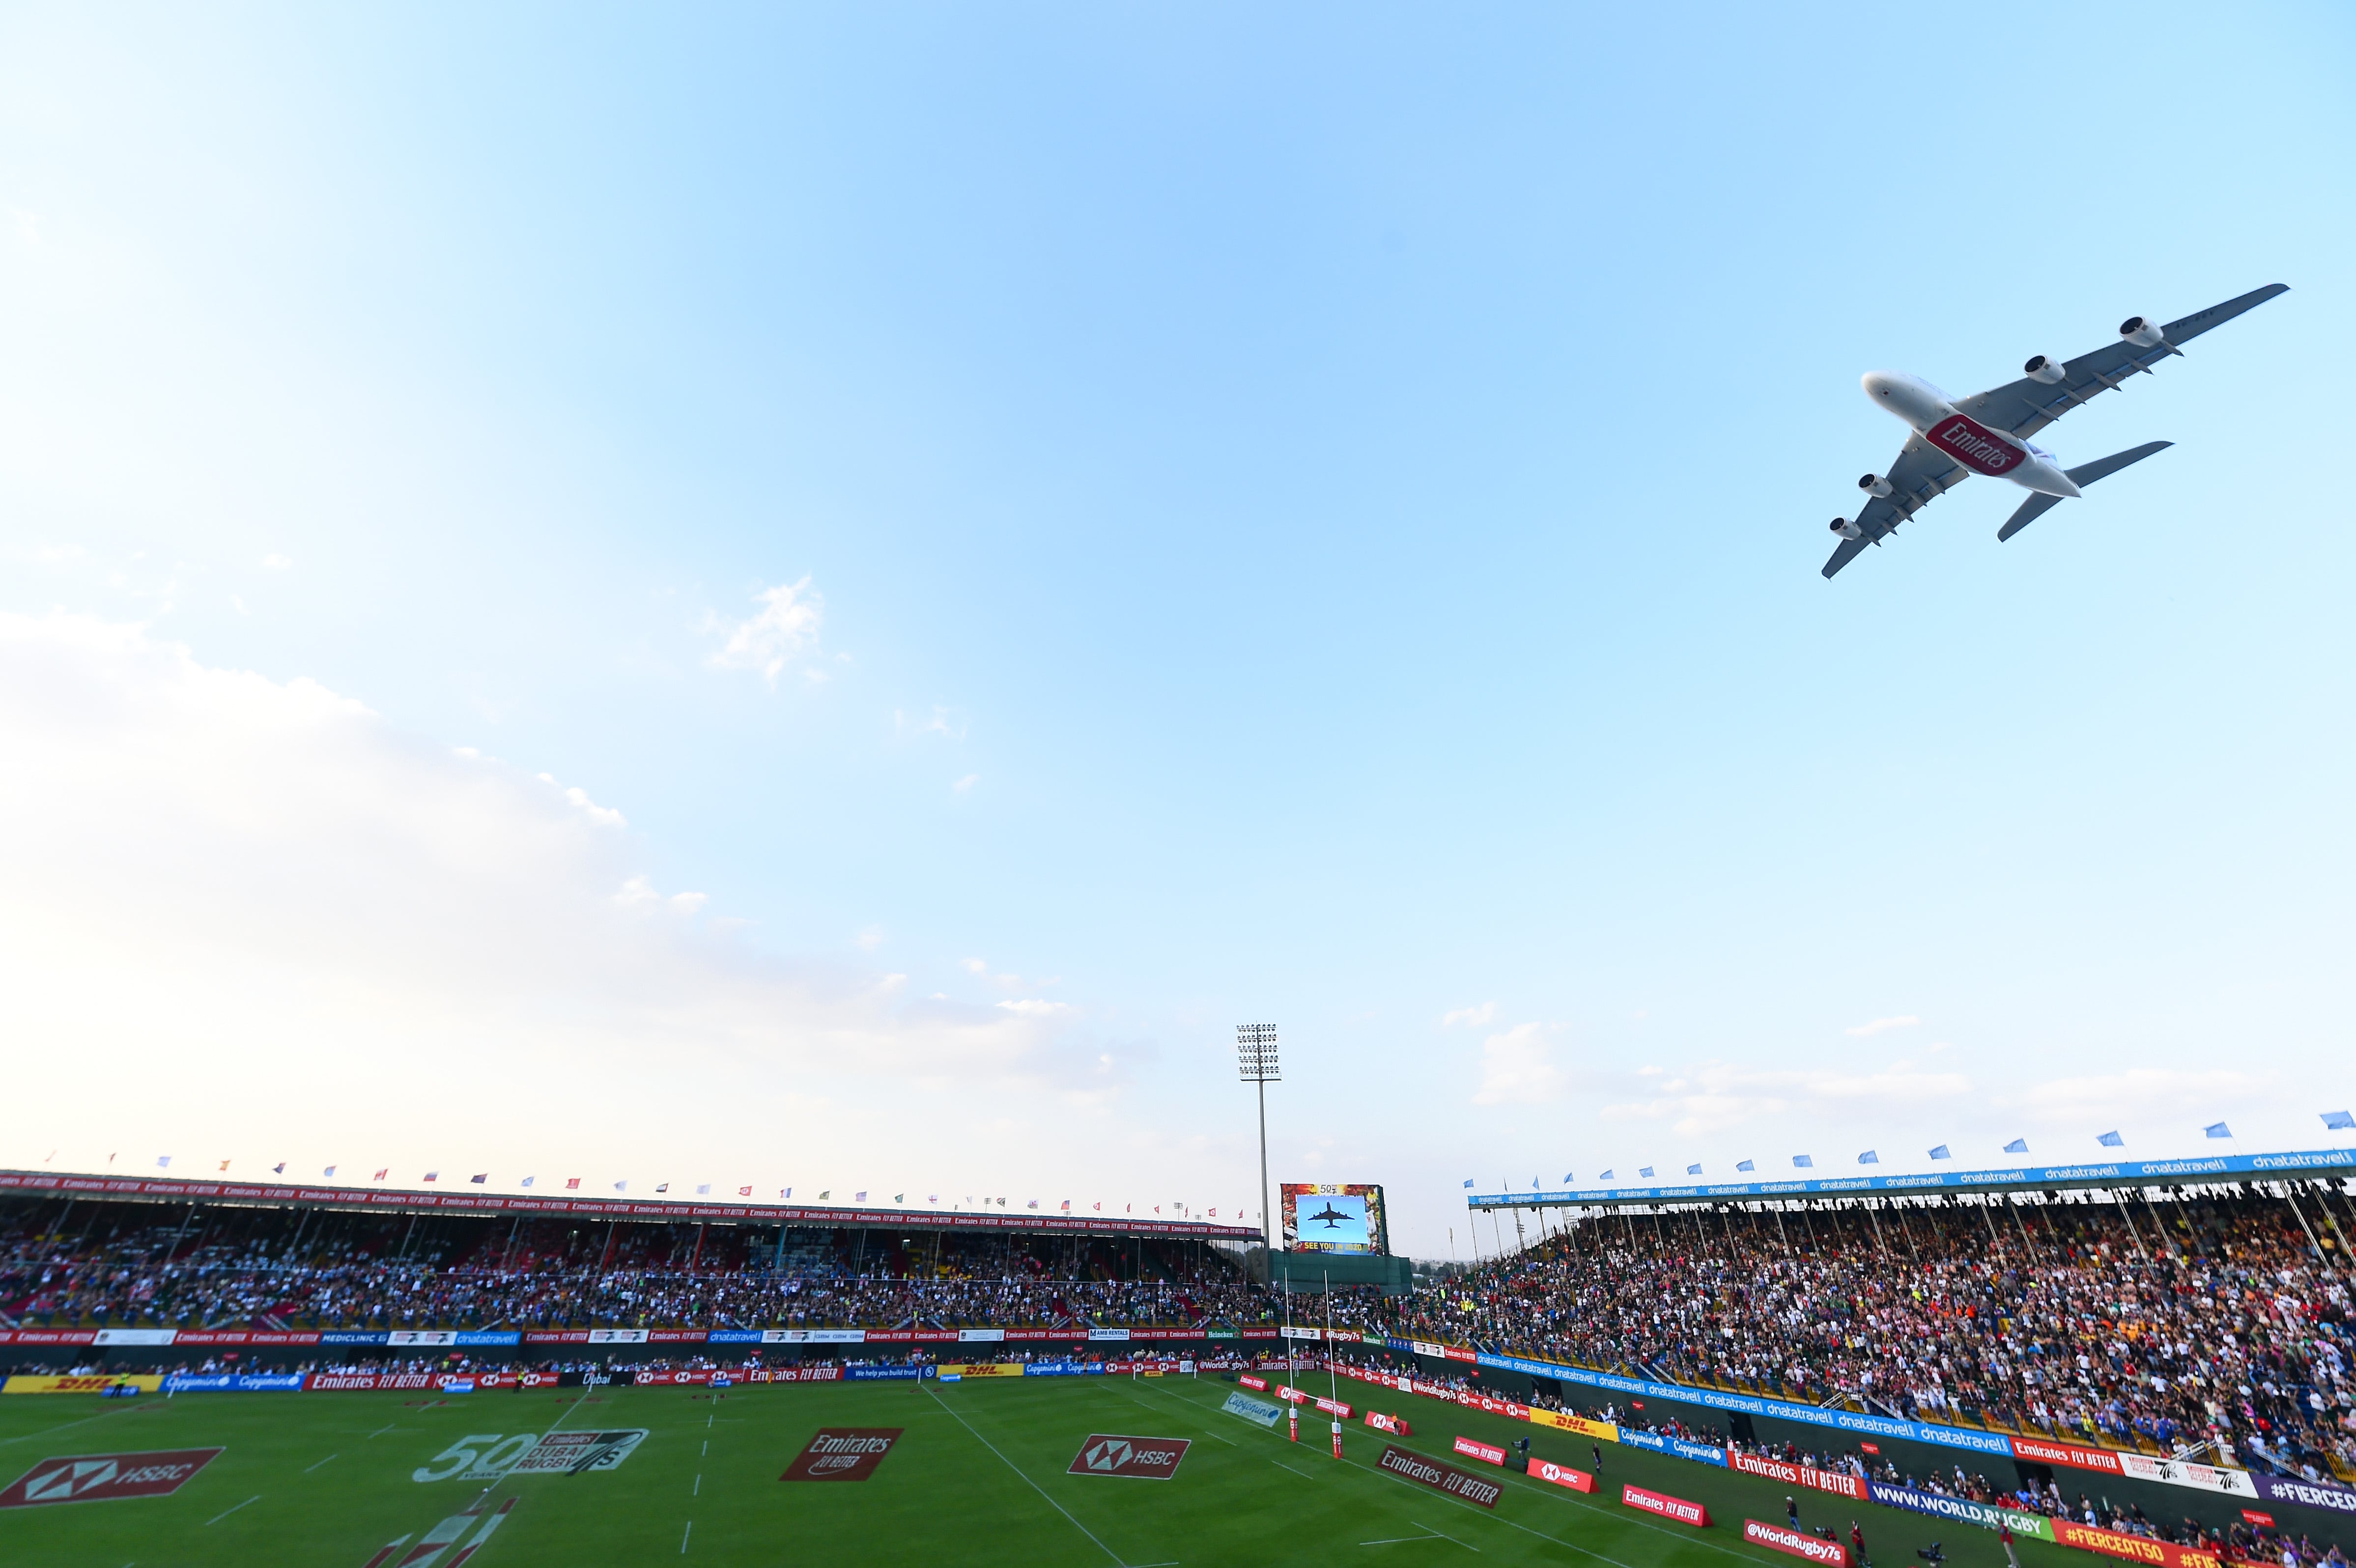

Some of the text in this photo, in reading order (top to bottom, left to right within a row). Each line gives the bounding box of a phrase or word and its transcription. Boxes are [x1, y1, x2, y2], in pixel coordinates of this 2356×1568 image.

[1941, 422, 2011, 468] Emirates
[1320, 1185, 1332, 1194] 50
[1326, 1330, 1360, 1341] #Rugby7s
[1363, 1335, 1381, 1344] Heineken
[965, 1366, 997, 1375] DHL
[1026, 1363, 1056, 1374] Capgemini
[1068, 1363, 1096, 1373] Capgeini
[1199, 1361, 1249, 1371] @WorldRgby7s
[238, 1375, 290, 1389] Capgemini
[312, 1375, 375, 1389] Emirates
[377, 1375, 394, 1389] FLY
[394, 1374, 429, 1388] BETTER
[582, 1372, 612, 1385] Dubai
[750, 1368, 838, 1381] Emrates FLY BETTER
[865, 1370, 876, 1379] help
[55, 1378, 113, 1389] DHL
[1413, 1381, 1457, 1400] @WorldRugby7s
[1227, 1394, 1270, 1417] Capgemini
[1555, 1415, 1589, 1433] DHL
[545, 1434, 596, 1444] Emirates
[808, 1434, 891, 1453] Emirates
[1621, 1429, 1656, 1447] Capgemini
[527, 1446, 586, 1458] DUBAI
[1455, 1440, 1480, 1456] Emirates
[1486, 1449, 1503, 1465] BETTER
[1673, 1440, 1712, 1459] Capgemini
[2015, 1442, 2069, 1462] Emirates
[2071, 1450, 2086, 1464] FLY
[2086, 1453, 2118, 1470] BETTER
[412, 1433, 539, 1482] 50
[515, 1458, 575, 1469] RUGBY
[830, 1455, 861, 1468] BETTER
[1133, 1450, 1176, 1466] HSBC
[114, 1463, 195, 1484] HSBC
[1381, 1450, 1499, 1505] Emirates FLY BETTER
[1561, 1471, 1578, 1484] HSBC
[1735, 1451, 1857, 1496] Emirates FLY BETTER
[1625, 1489, 1700, 1522] Emirates FLY BETTER
[1747, 1523, 1841, 1562] @WorldRugby7s
[2065, 1527, 2165, 1563] #FIERCEAT50
